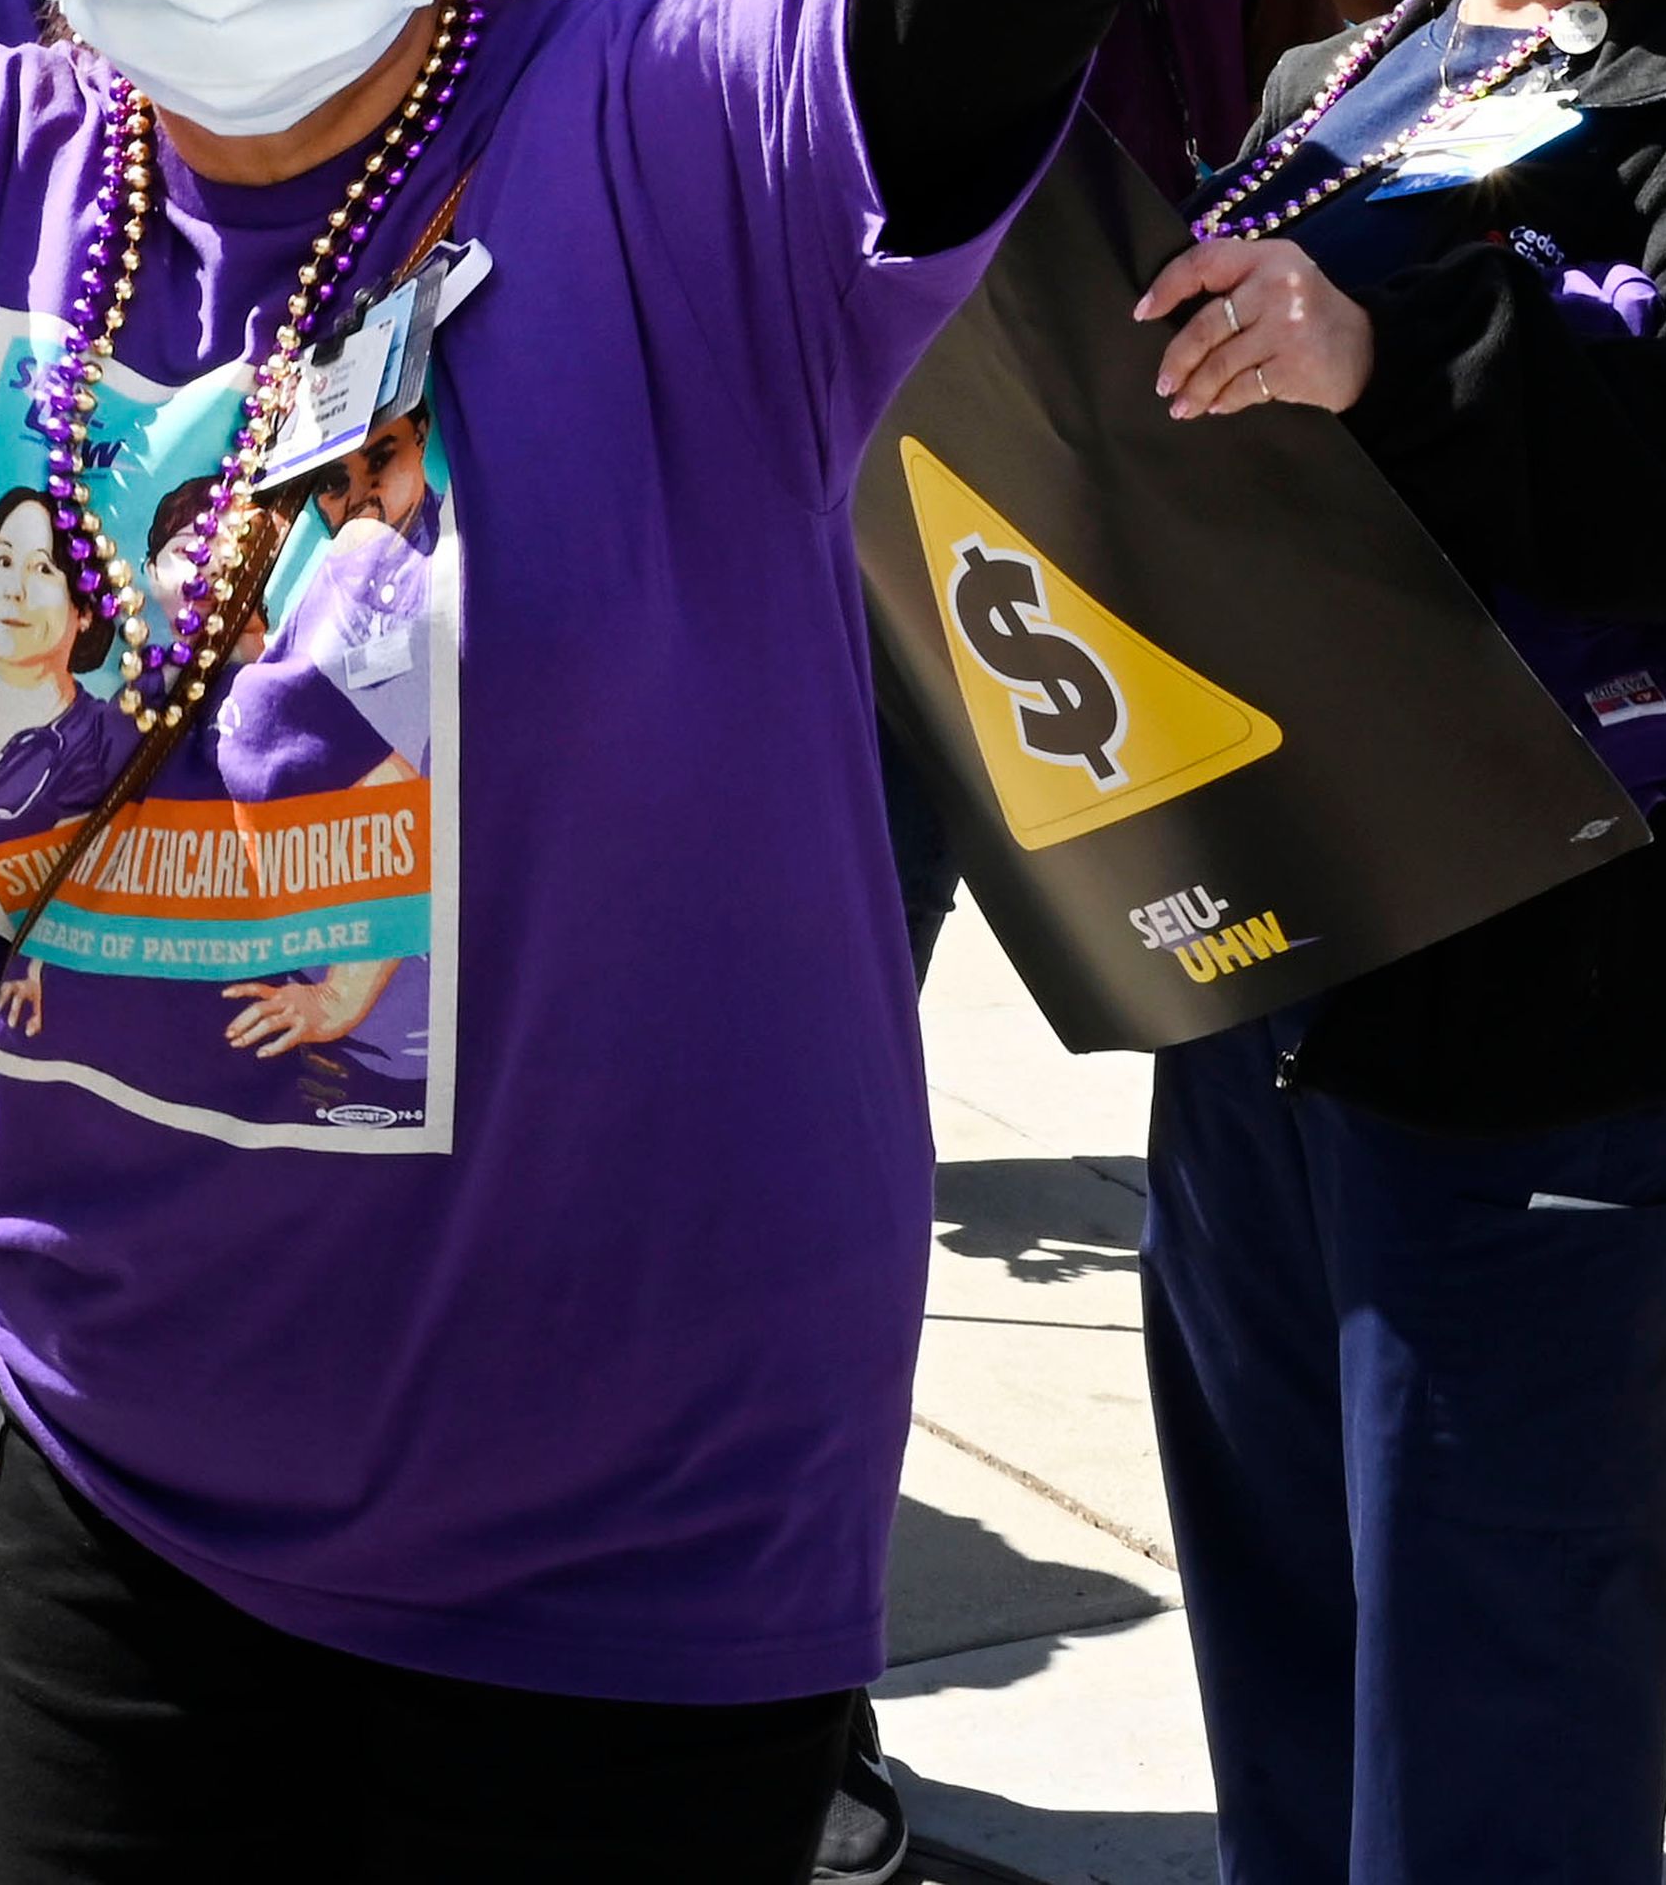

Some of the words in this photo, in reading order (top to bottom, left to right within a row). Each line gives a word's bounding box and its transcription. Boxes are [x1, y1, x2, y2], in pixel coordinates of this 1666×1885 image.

[255, 808, 415, 899] WORKERS
[101, 935, 136, 959] OF
[142, 936, 273, 963] PATIENT
[282, 920, 371, 956] CARE
[1128, 885, 1230, 950] SEIU-
[1174, 911, 1290, 984] UHW
